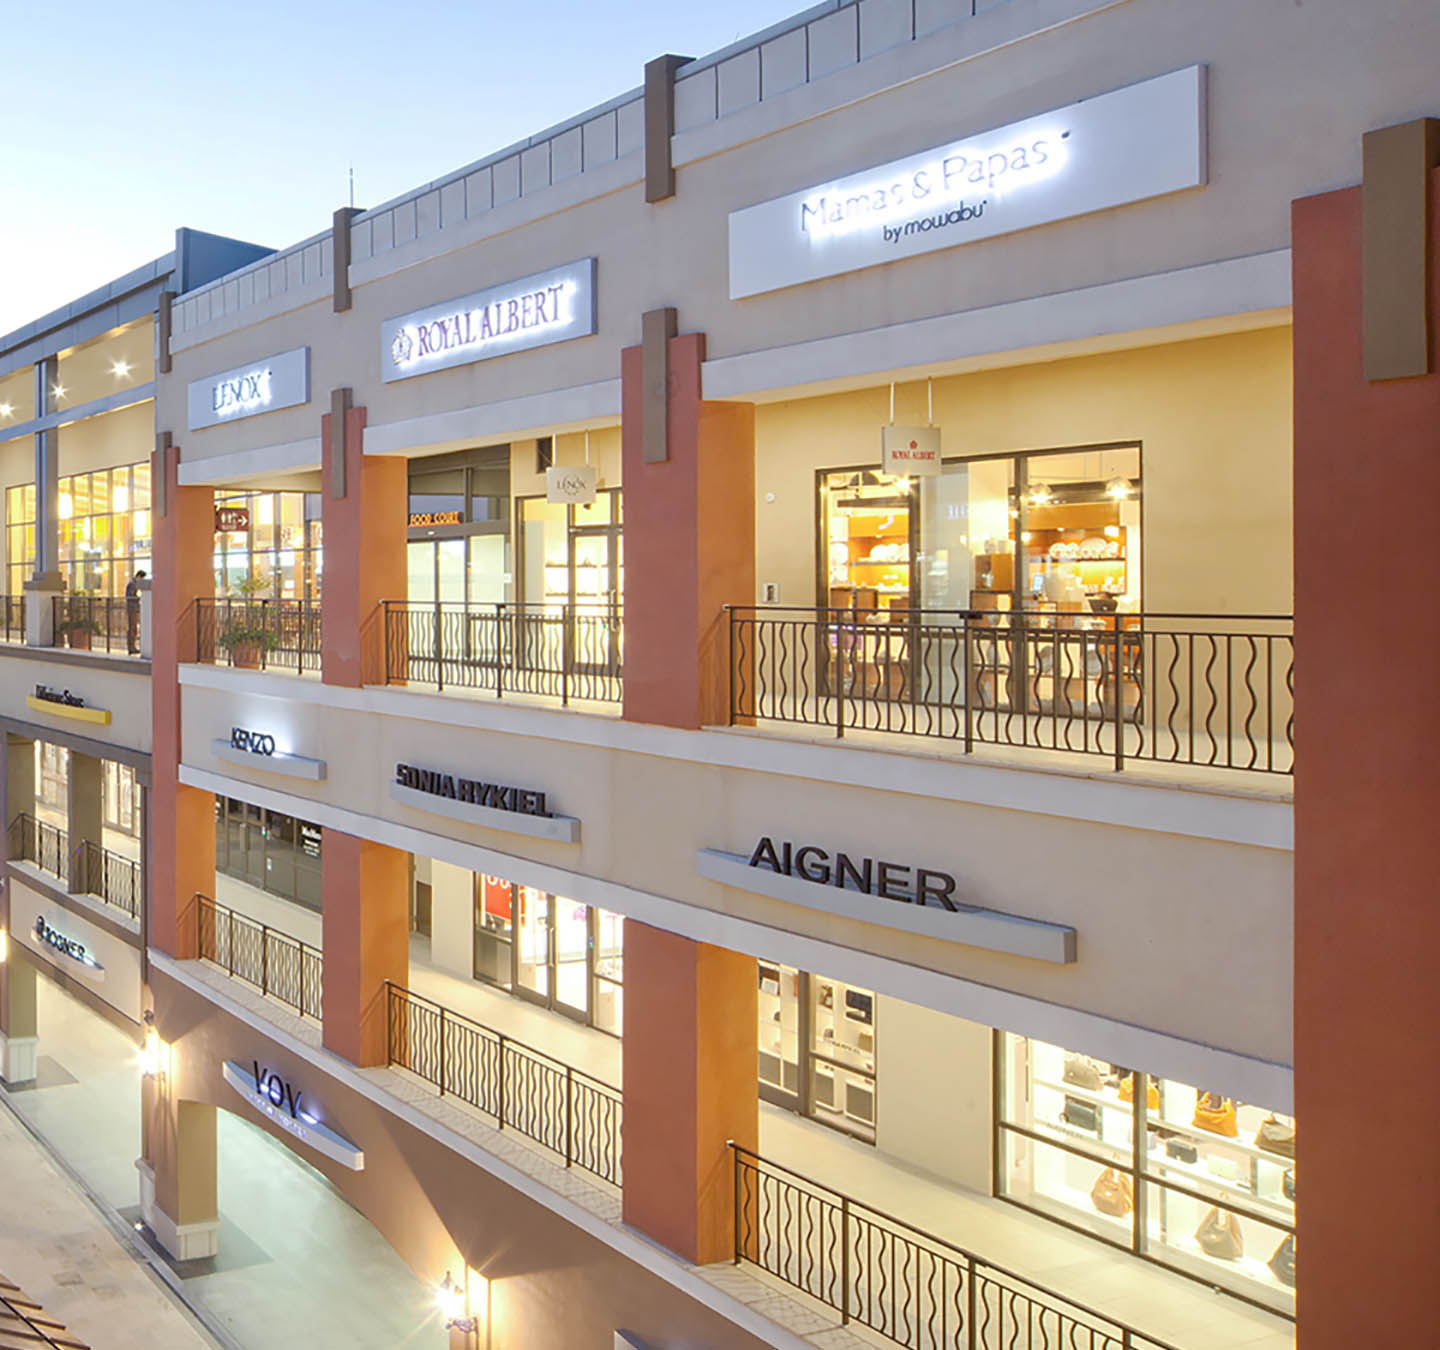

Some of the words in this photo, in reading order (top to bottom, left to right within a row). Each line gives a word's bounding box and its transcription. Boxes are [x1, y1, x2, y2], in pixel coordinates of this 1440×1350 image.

[801, 183, 903, 231] Mamas
[912, 170, 931, 199] &
[942, 140, 1048, 190] Papas
[883, 225, 902, 244] by
[904, 200, 984, 236] mowabu
[417, 312, 477, 357] ROYAL
[480, 283, 564, 340] ALBERT
[212, 374, 262, 411] LENOX
[231, 727, 275, 756] KENZO
[396, 763, 457, 800] SONIA
[458, 778, 553, 818] RYKIEL
[748, 837, 959, 913] AIGNER
[253, 1060, 302, 1119] VOV
